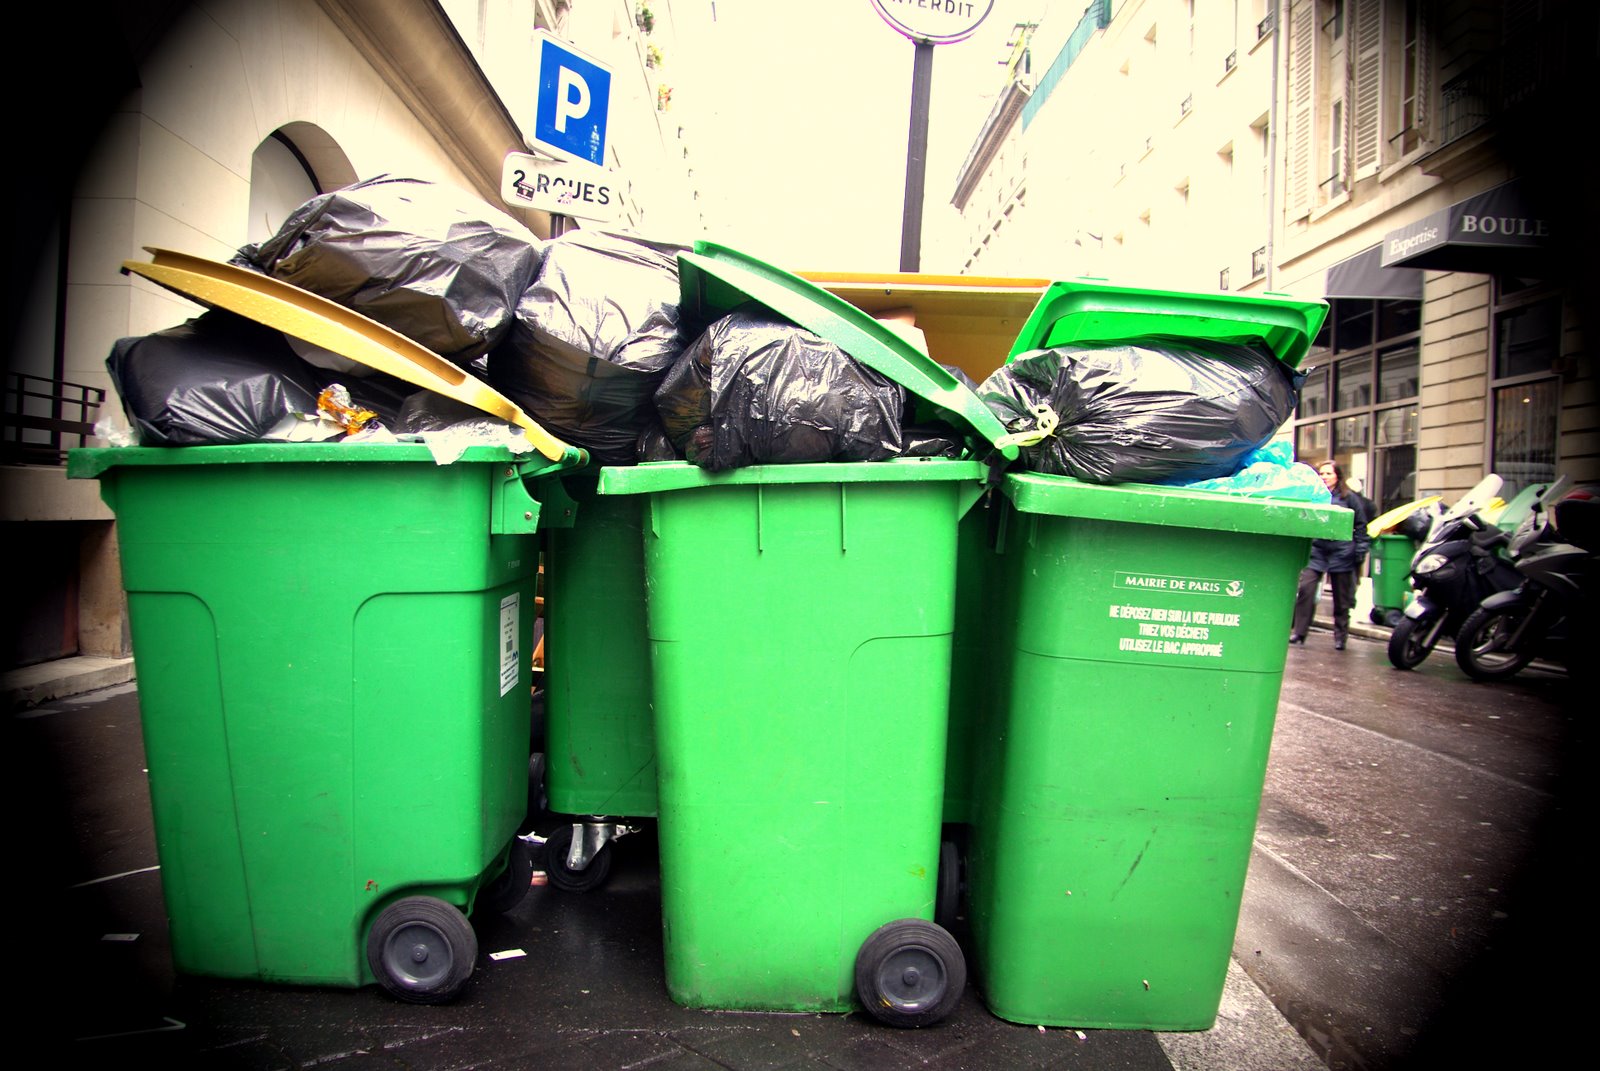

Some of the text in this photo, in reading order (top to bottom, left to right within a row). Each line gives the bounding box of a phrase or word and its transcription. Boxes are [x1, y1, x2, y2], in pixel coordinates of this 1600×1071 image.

[555, 65, 591, 134] P
[513, 169, 526, 188] 2
[1389, 226, 1438, 256] Expertise
[1125, 576, 1220, 592] MAIRIE DE PARIS
[1168, 609, 1182, 622] SUR
[1182, 610, 1191, 623] LA
[1192, 611, 1208, 624] VOIE
[1208, 612, 1240, 626] PUBLIQUE
[1139, 623, 1209, 640] TRIEZ VOS DÉCHETS
[1119, 638, 1223, 657] UTILISEZ LE BAC APPROPRIÉ
